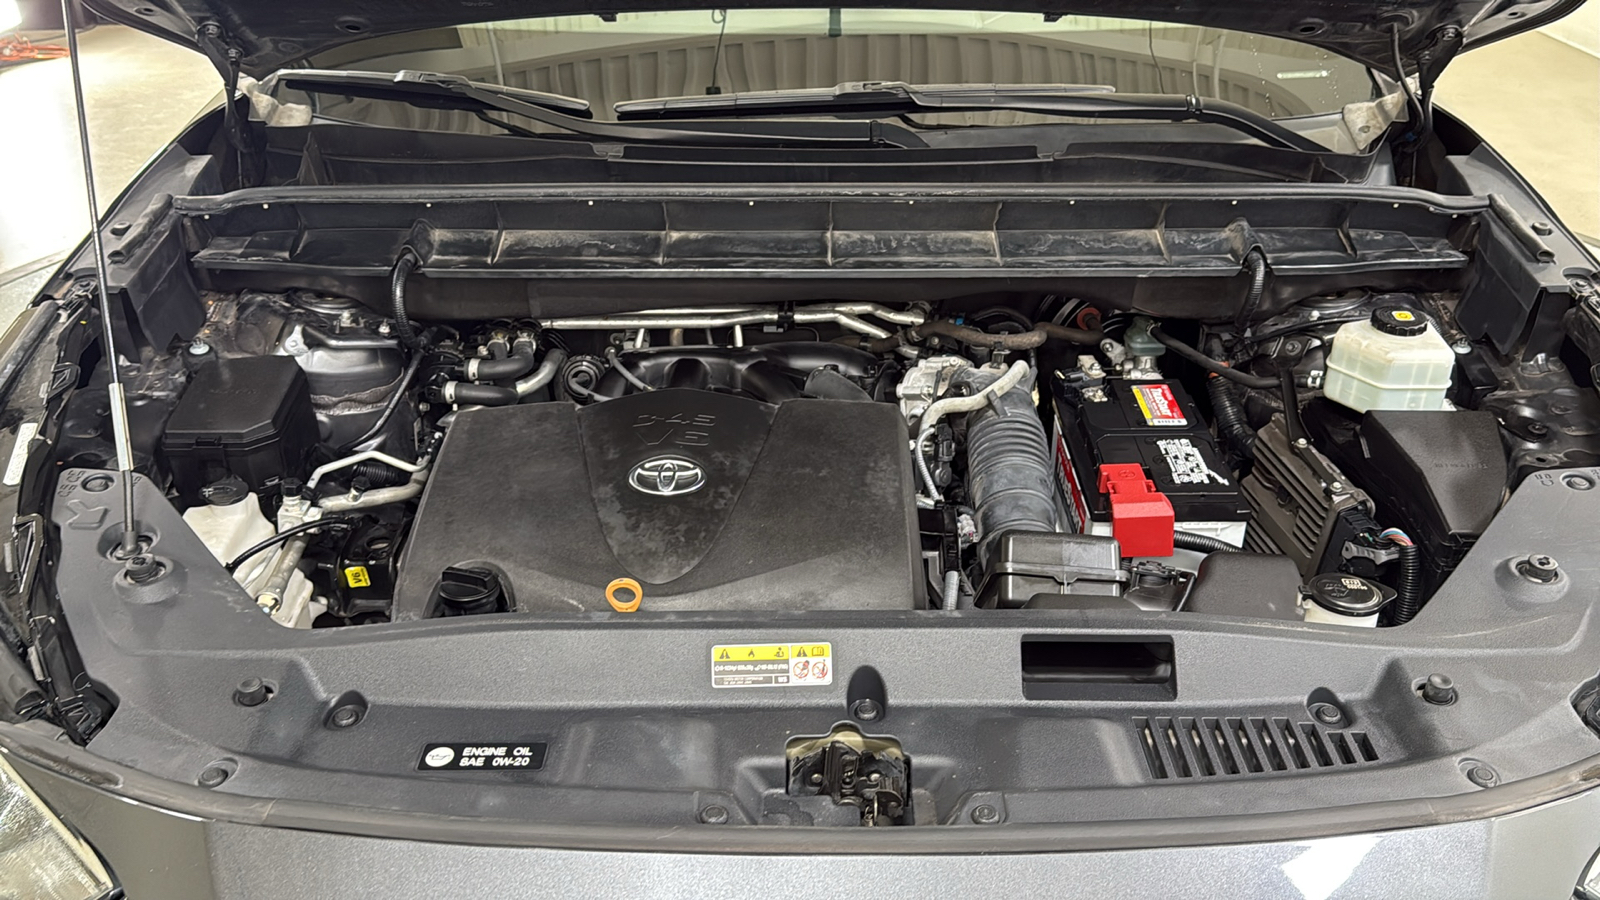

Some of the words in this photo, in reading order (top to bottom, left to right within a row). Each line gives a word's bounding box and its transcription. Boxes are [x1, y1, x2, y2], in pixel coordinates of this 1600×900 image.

[351, 572, 362, 584] V6
[462, 746, 508, 756] ENGINE
[513, 747, 533, 756] OIL
[459, 757, 486, 766] SAE
[491, 757, 530, 766] 0W-20
